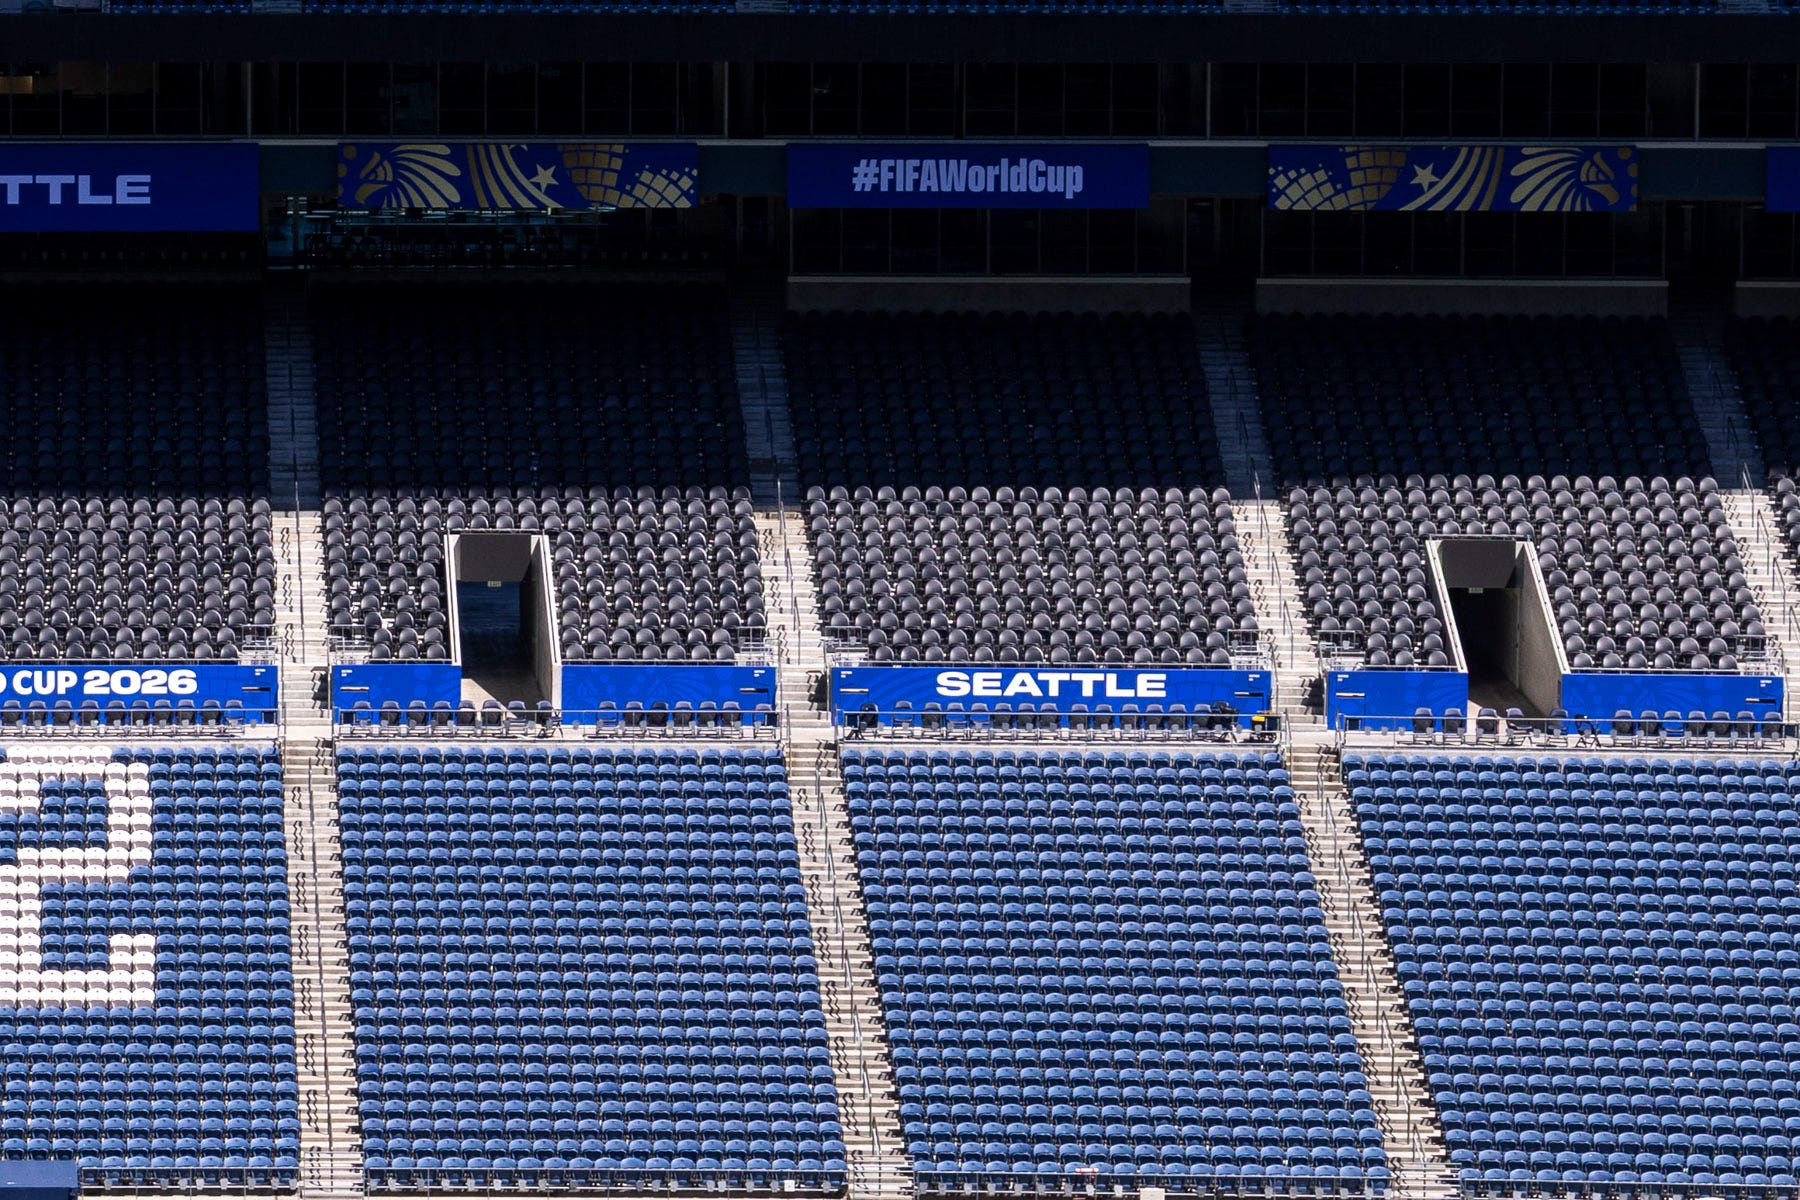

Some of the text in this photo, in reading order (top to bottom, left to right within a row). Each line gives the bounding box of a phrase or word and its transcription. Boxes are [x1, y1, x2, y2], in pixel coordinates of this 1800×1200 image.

[852, 158, 1083, 199] #FIFAWorldCup
[13, 670, 78, 696] CUP
[83, 669, 198, 695] 2026
[936, 671, 1167, 697] SEATTLE
